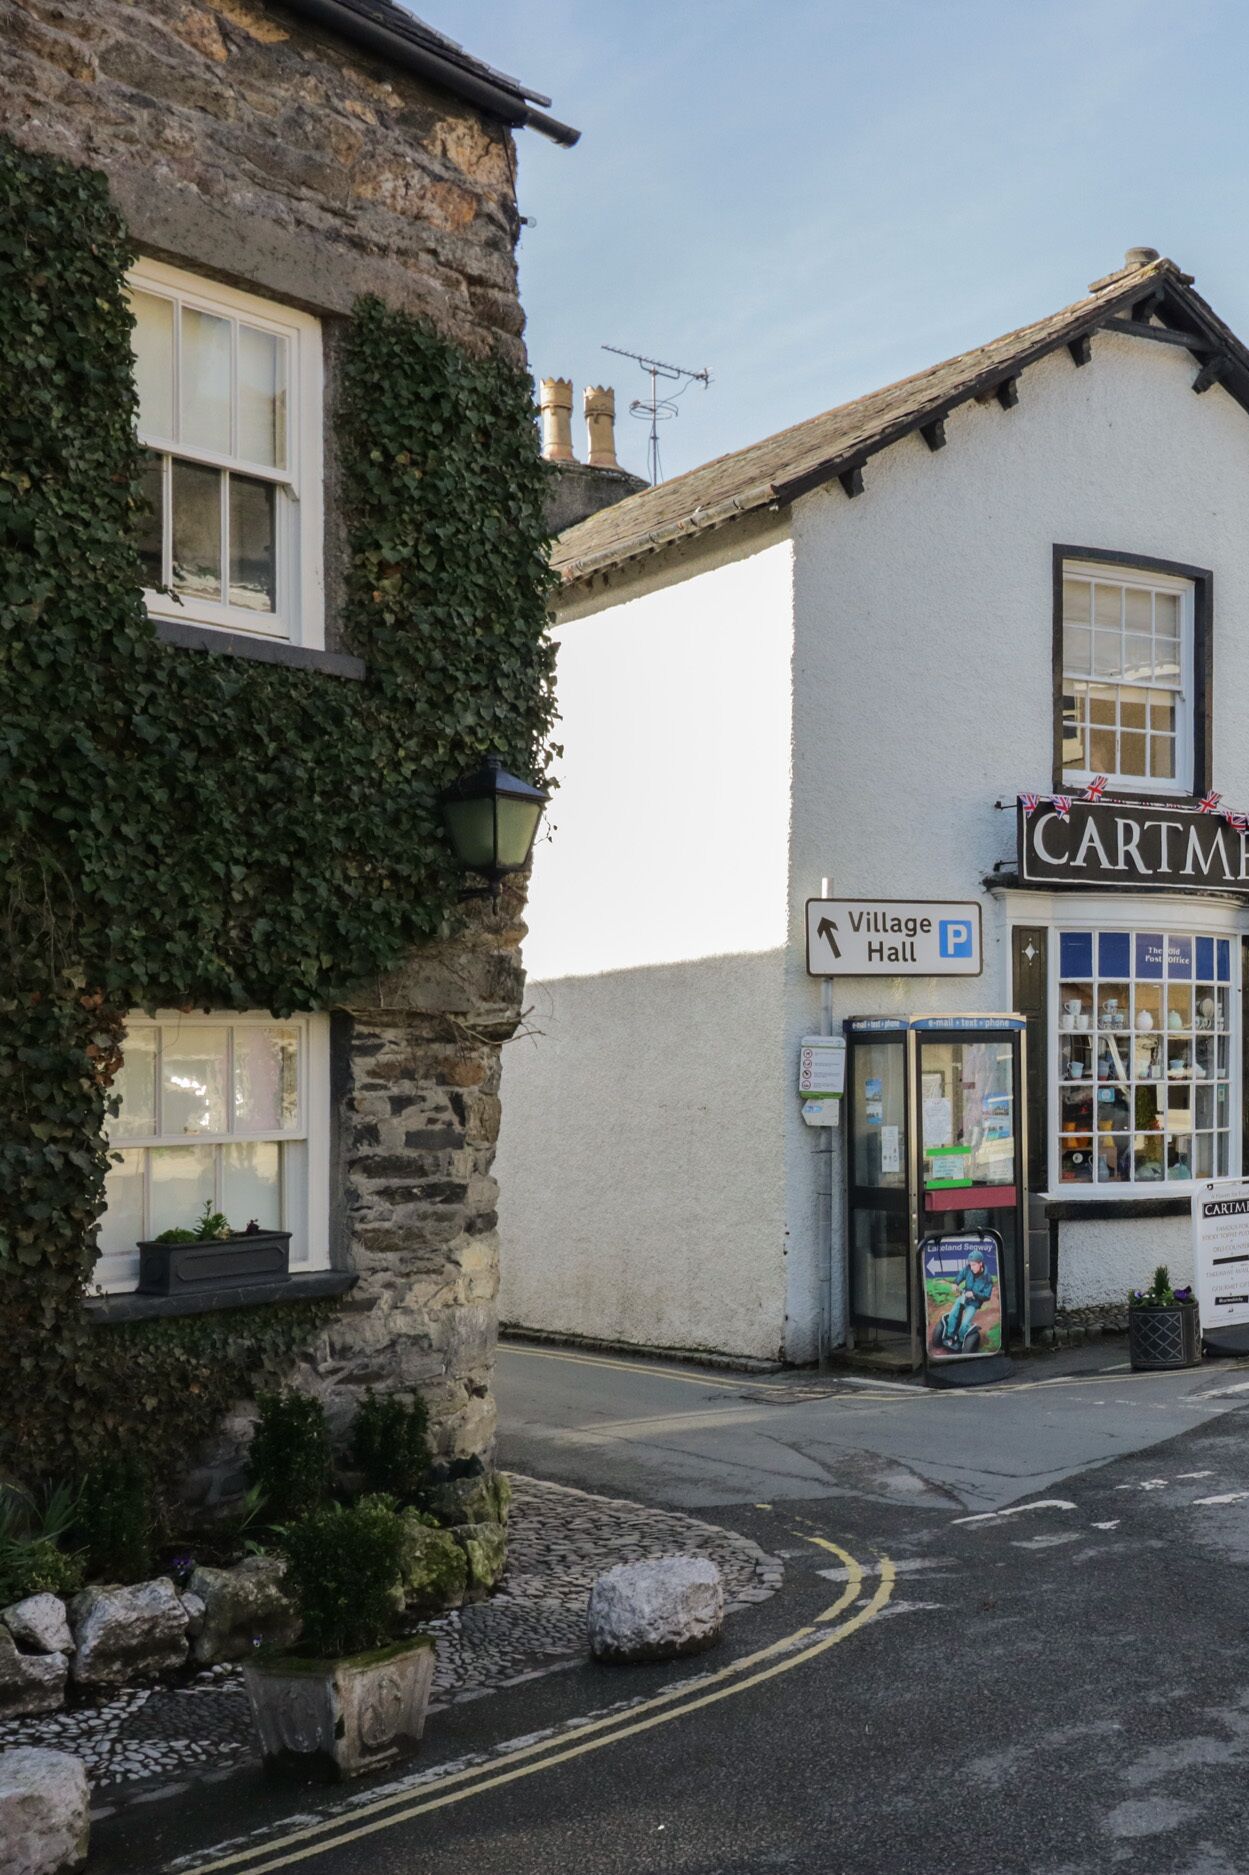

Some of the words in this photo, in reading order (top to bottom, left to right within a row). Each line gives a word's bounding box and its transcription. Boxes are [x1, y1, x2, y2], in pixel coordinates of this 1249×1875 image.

[848, 911, 932, 938] Village
[947, 924, 967, 955] P
[867, 941, 917, 963] Hall
[1148, 946, 1163, 954] The
[1145, 955, 1162, 963] Post
[1168, 956, 1190, 965] Office
[928, 1018, 954, 1028] e-mail
[961, 1018, 978, 1028] text
[985, 1018, 1010, 1029] phone
[963, 1242, 993, 1253] Segway
